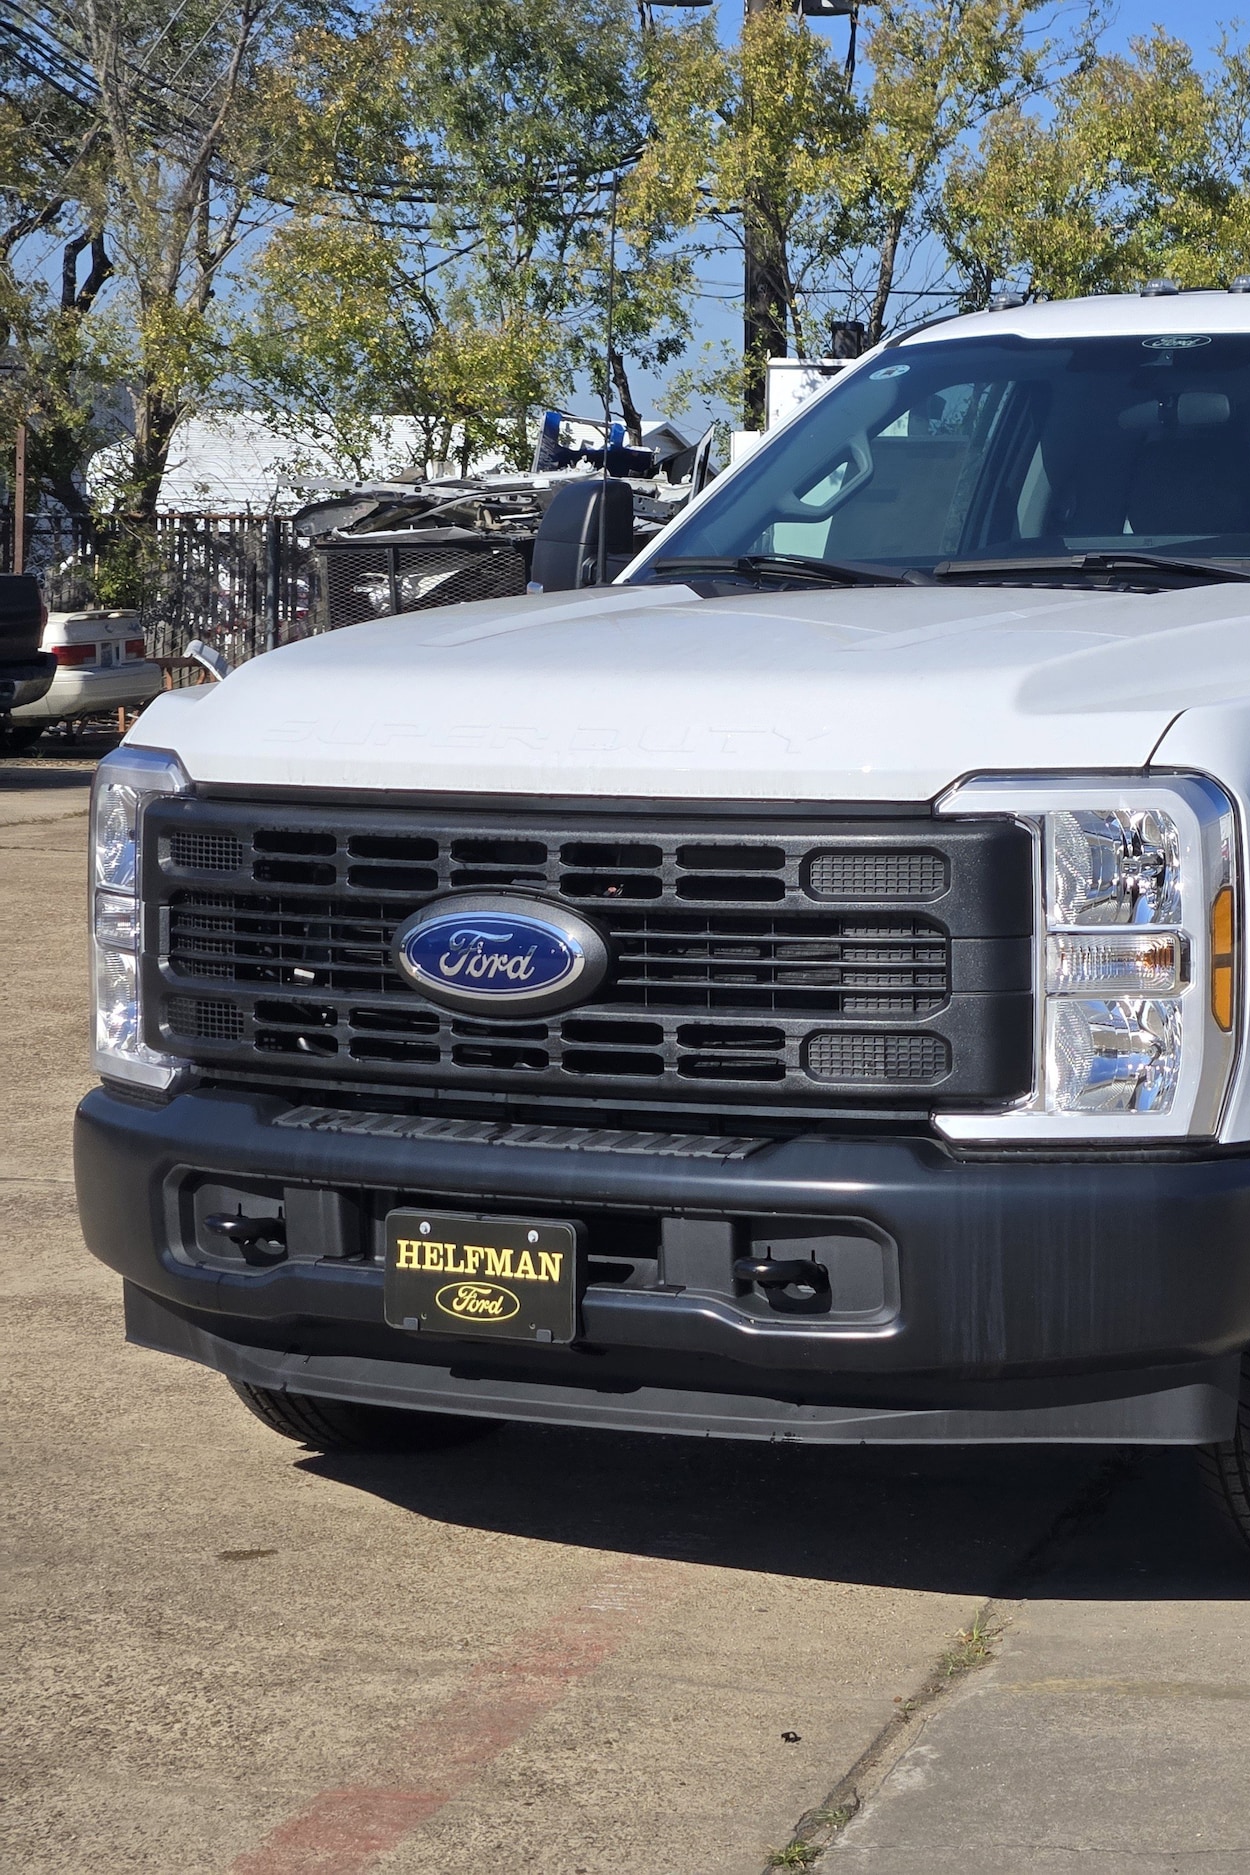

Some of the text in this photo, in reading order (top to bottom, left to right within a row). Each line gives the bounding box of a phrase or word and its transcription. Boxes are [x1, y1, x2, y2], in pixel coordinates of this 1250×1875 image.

[262, 719, 832, 755] SUPER DUTY
[439, 928, 539, 981] Ford
[396, 1239, 563, 1282] HELFMAN
[452, 1285, 504, 1315] Ford
